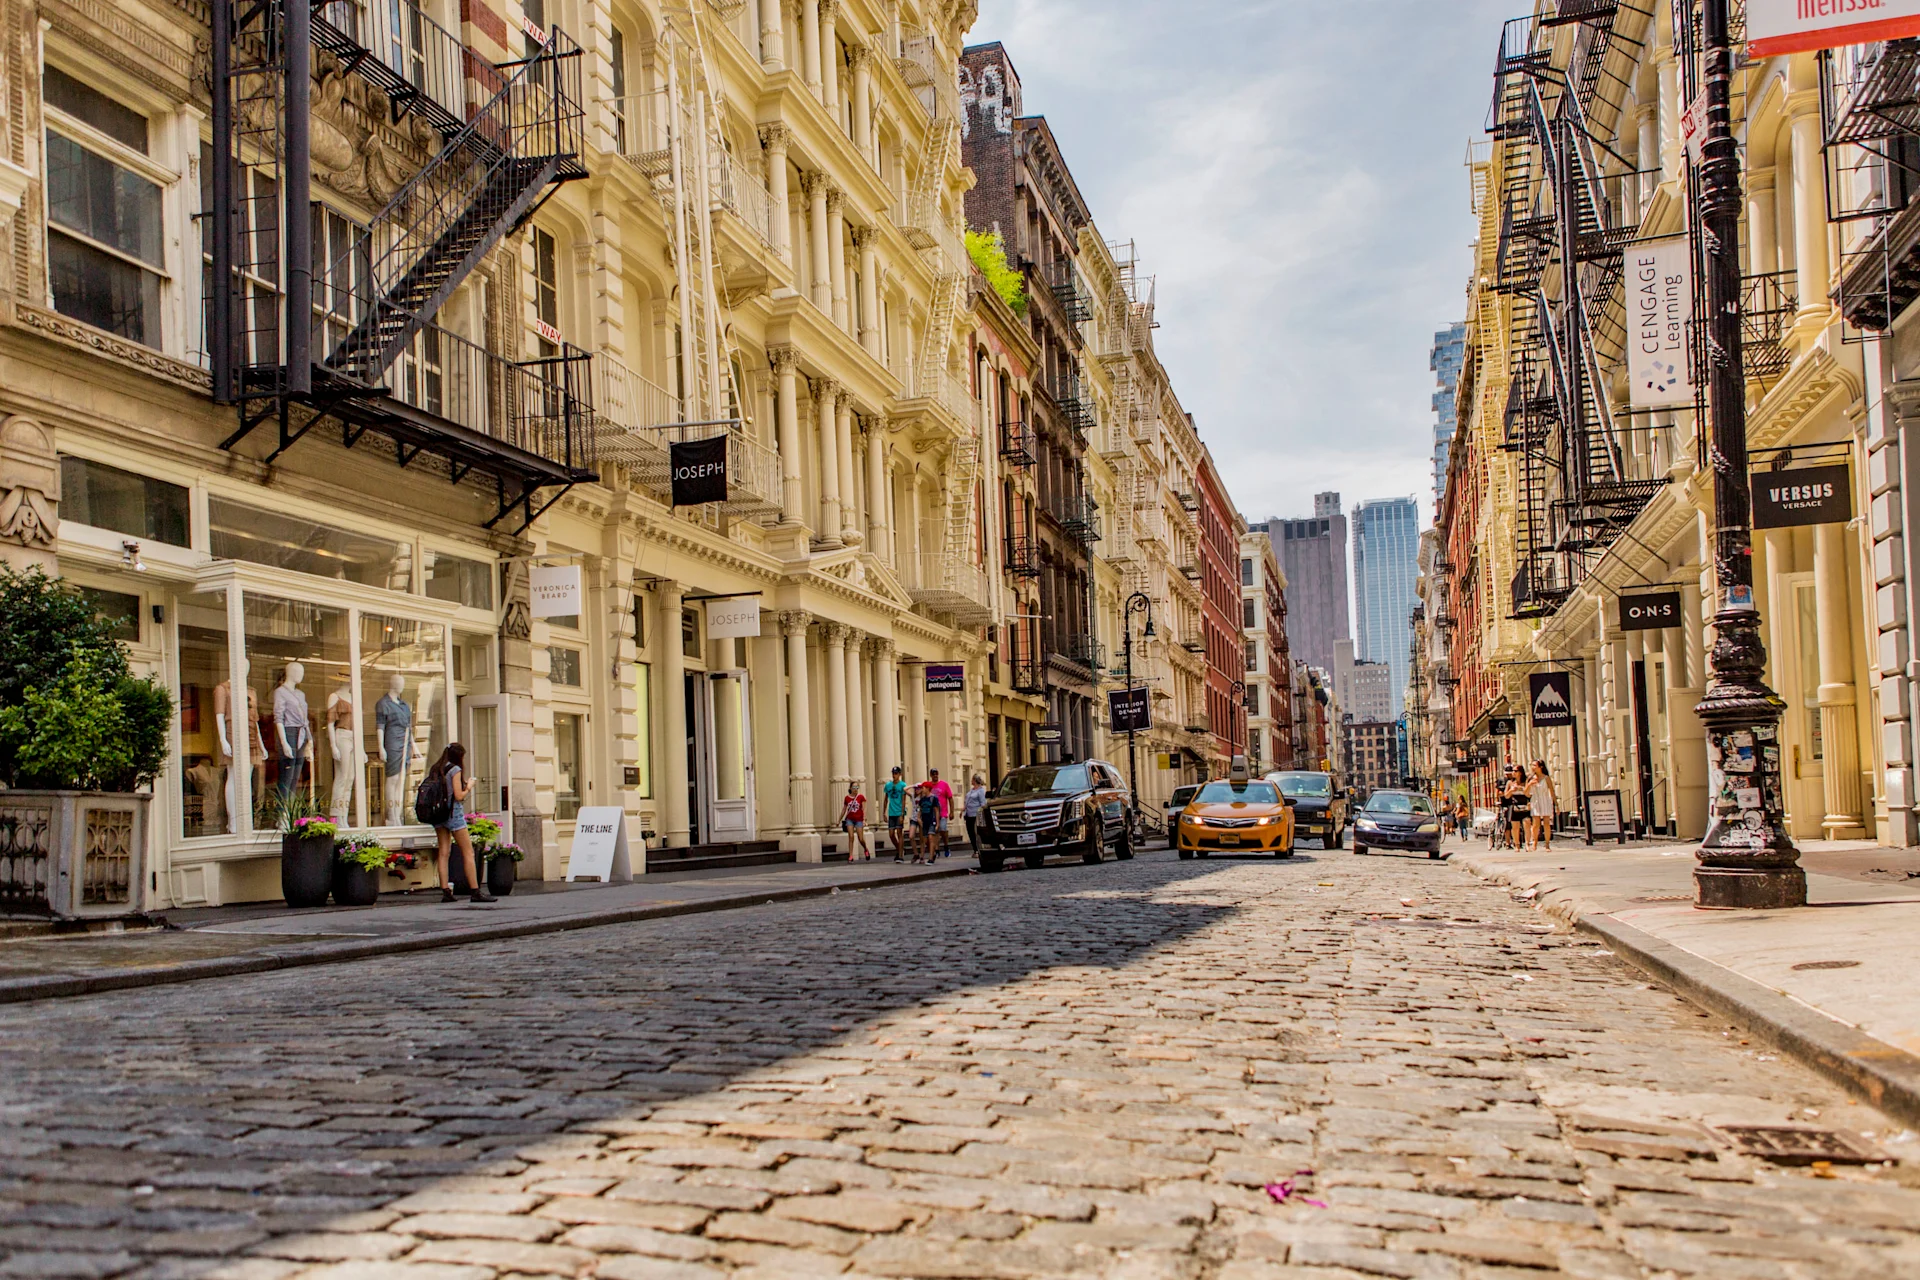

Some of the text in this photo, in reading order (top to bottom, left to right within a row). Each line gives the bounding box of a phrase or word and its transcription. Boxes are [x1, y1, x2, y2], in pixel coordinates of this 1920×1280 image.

[1682, 113, 1695, 135] NO
[1638, 256, 1659, 354] CENGAGE
[1662, 274, 1683, 351] Learning
[673, 462, 724, 481] JOSEPH
[1769, 483, 1834, 503] VERSUS
[1782, 500, 1823, 510] VERSACE
[532, 584, 576, 592] VERONICA
[541, 592, 568, 600] BEARD
[710, 613, 755, 626] JOSEPH
[928, 681, 961, 690] patagonia
[1114, 701, 1144, 709] INTEIOR
[1535, 711, 1569, 720] BURTON
[581, 825, 613, 834] THE LINE
